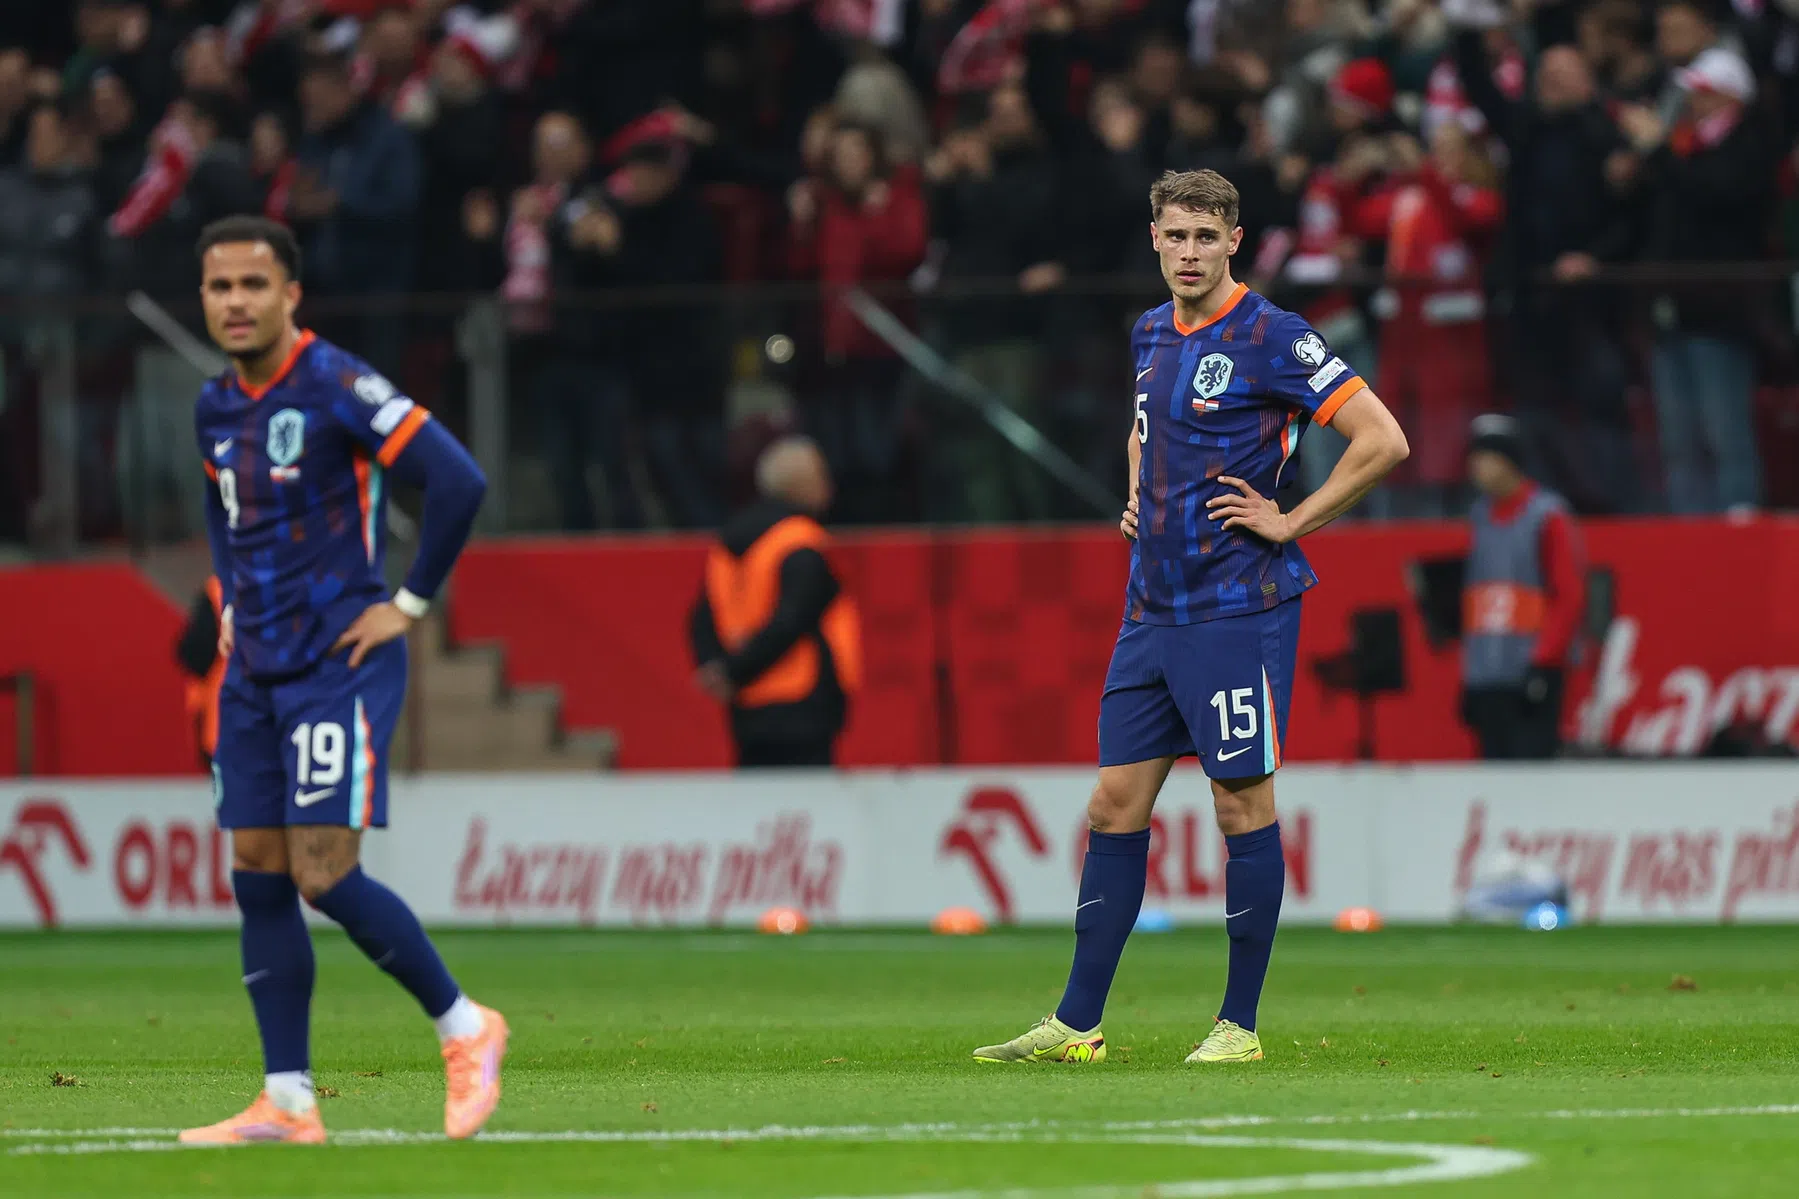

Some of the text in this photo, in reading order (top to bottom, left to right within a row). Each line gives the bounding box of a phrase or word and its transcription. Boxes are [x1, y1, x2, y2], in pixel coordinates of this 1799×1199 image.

[1210, 687, 1257, 740] 15
[291, 721, 346, 785] 19
[114, 819, 236, 909] ORL
